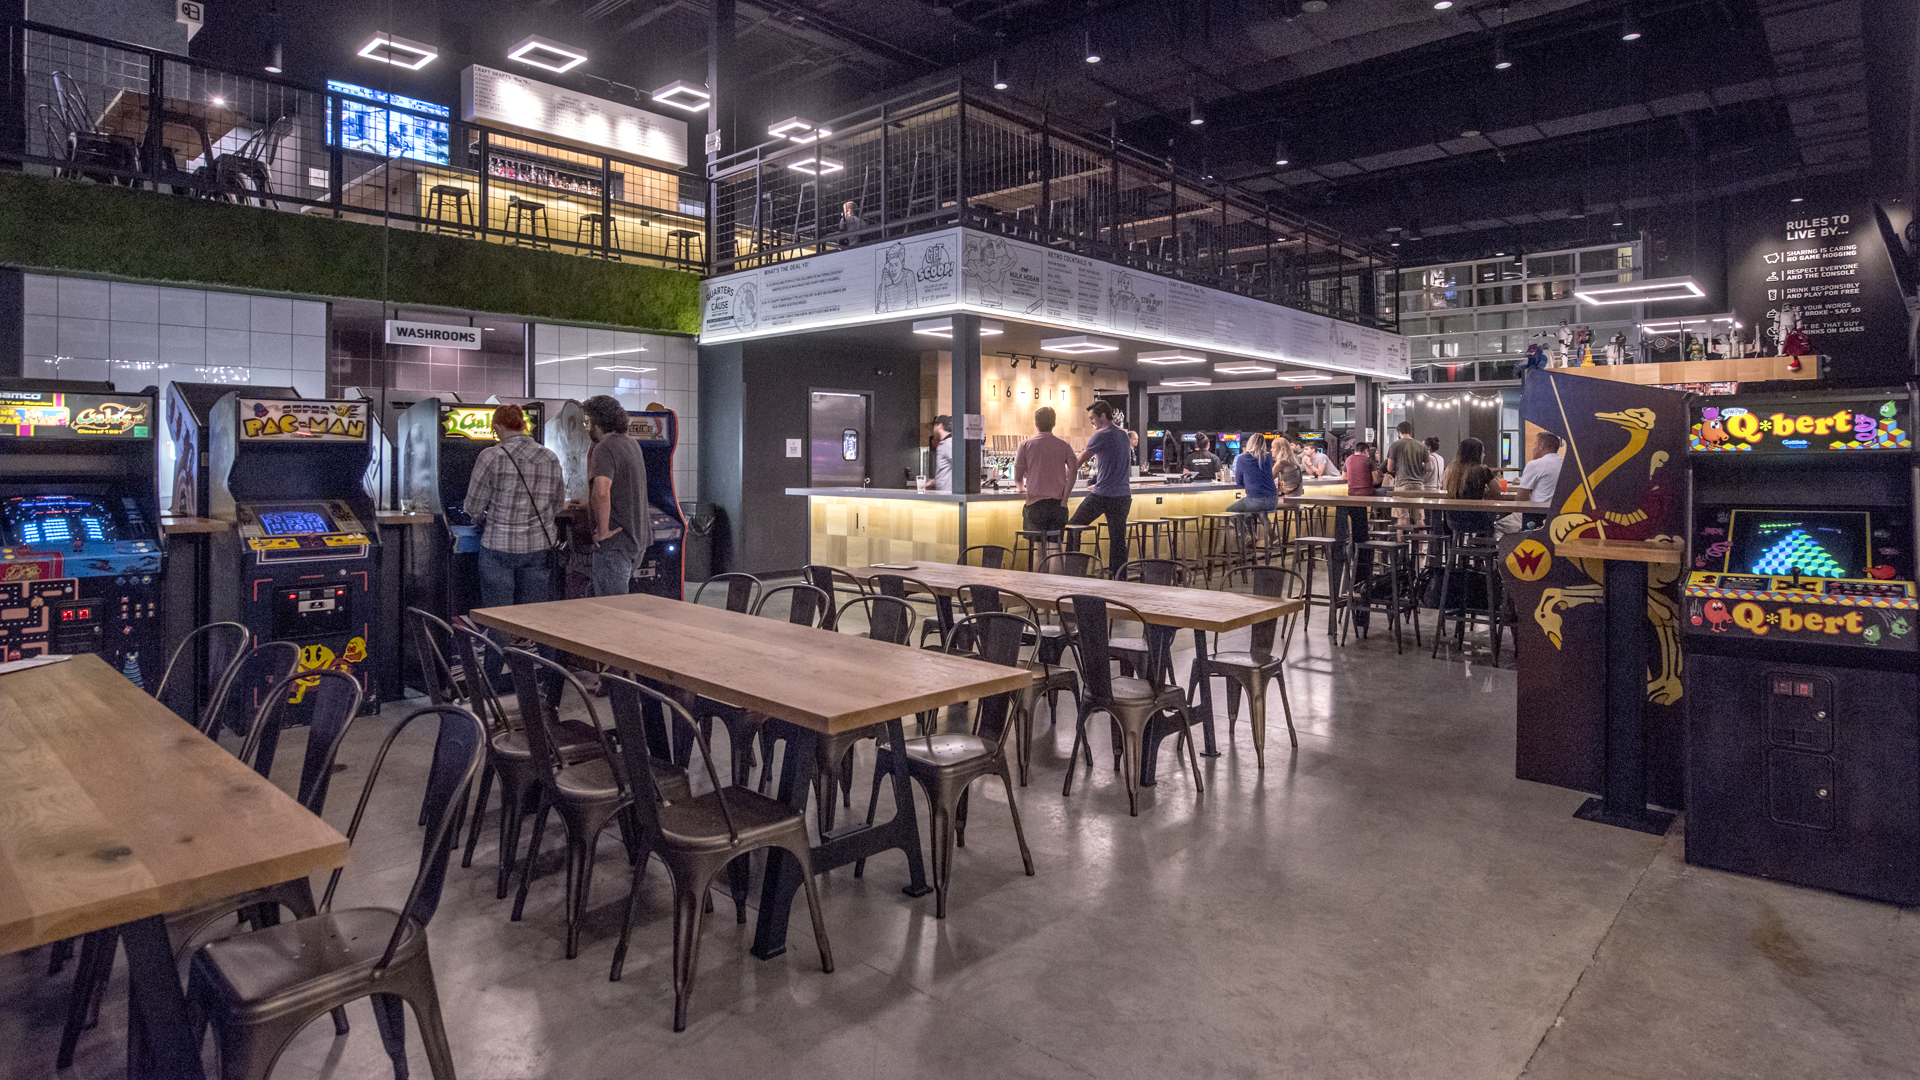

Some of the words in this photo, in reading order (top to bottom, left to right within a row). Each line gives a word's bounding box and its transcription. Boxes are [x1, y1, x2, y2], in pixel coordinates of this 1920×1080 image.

[475, 67, 491, 75] CRAFT
[492, 71, 511, 80] DRAFTS
[1786, 217, 1828, 230] RULES
[1832, 214, 1850, 224] TO
[1786, 229, 1816, 240] LIVE
[1820, 227, 1849, 237] BY...
[926, 243, 944, 263] GET
[1786, 248, 1818, 256] SHARING
[1829, 244, 1857, 252] CARING
[1823, 250, 1857, 258] HOGGING
[1048, 251, 1063, 260] RETRO
[1064, 255, 1087, 266] COCKTAILS
[764, 268, 780, 276] WHAT'S
[917, 261, 955, 282] SCOOP!
[1786, 267, 1818, 275] RESPECT
[1820, 263, 1859, 271] EVERYONE
[1821, 269, 1855, 277] CONSOLE
[1010, 271, 1022, 279] HULK
[1023, 274, 1039, 282] HOGAN
[1811, 282, 1860, 292] RESPONSIBLY
[706, 286, 734, 301] QUARTERS
[711, 300, 728, 311] CAUSE
[1153, 299, 1163, 307] PUFT
[396, 326, 476, 343] WASHROOMS
[282, 405, 330, 415] SUPER
[242, 413, 365, 438] PAC-MAN
